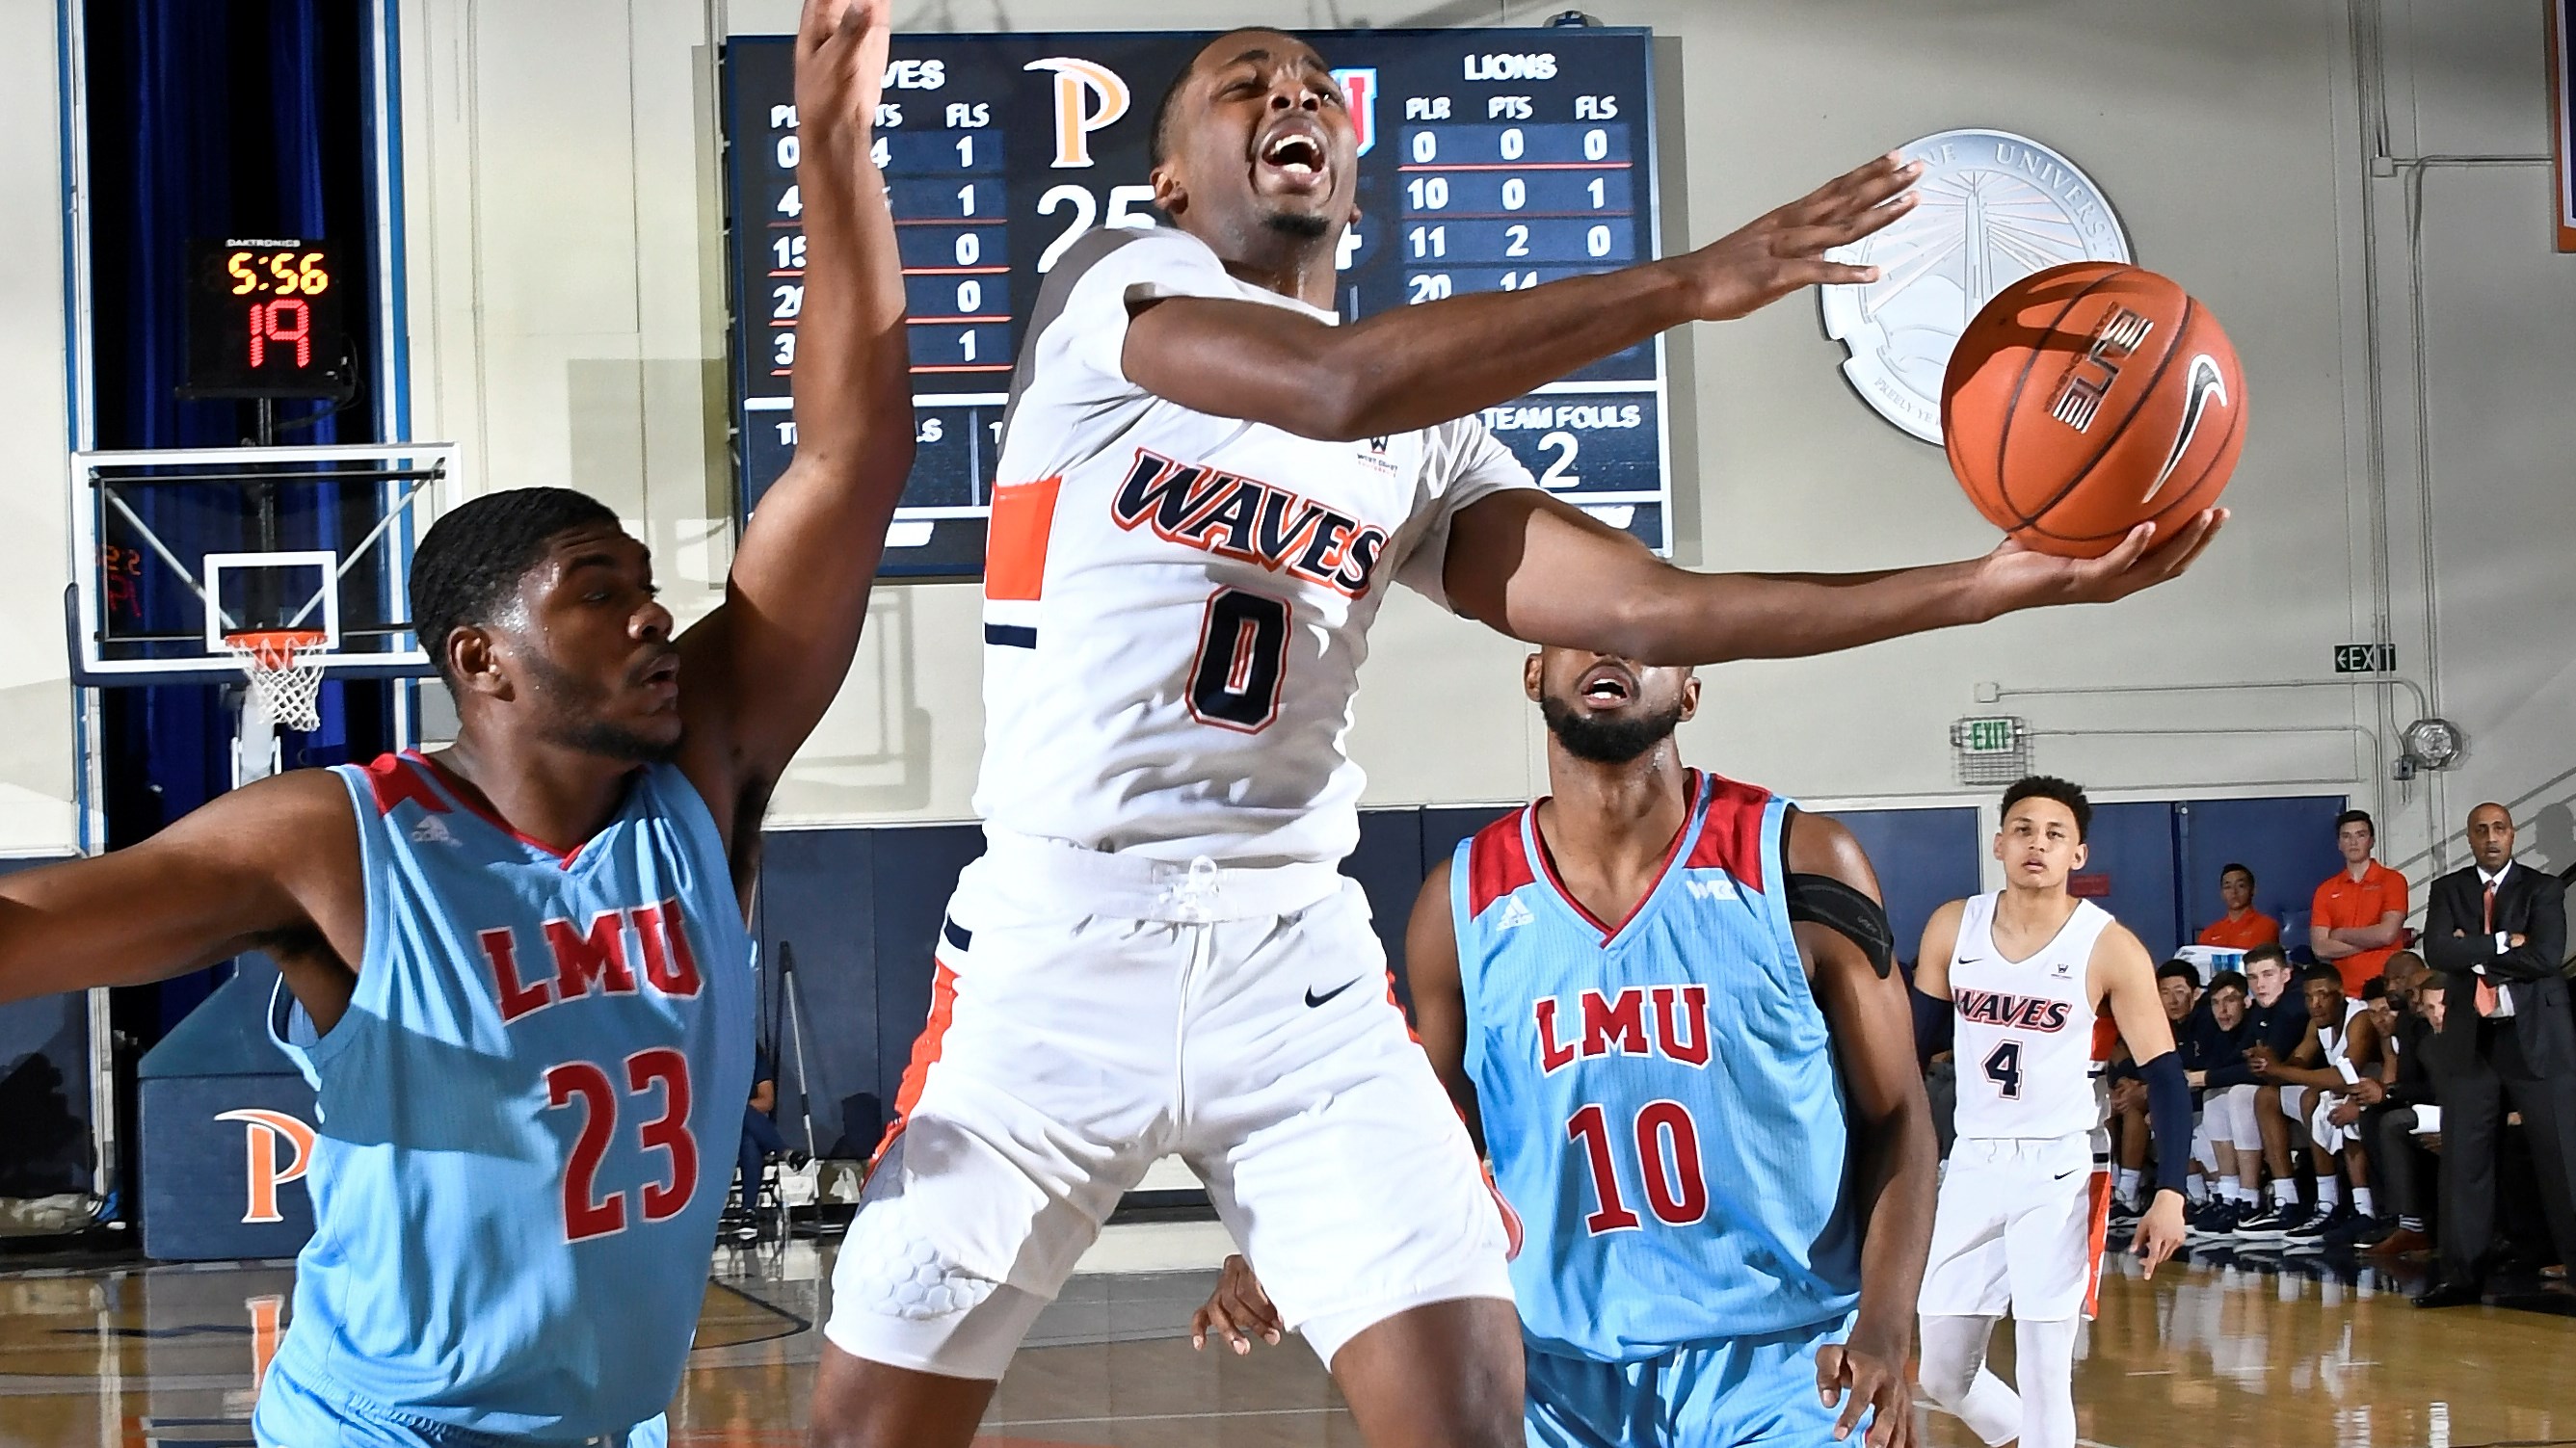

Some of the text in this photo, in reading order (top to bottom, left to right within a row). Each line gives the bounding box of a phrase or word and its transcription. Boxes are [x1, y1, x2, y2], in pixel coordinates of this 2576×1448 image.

[881, 59, 945, 90] VES
[1464, 53, 1557, 81] LIONS
[771, 102, 990, 128] PL TS FLS
[1023, 57, 1130, 168] P
[1406, 95, 1618, 120] PLR PTS FLS
[777, 136, 800, 169] 0
[955, 136, 973, 168] 1
[1412, 128, 1607, 163] 0 0 0
[957, 184, 974, 217] 1
[1407, 177, 1605, 210] 10 0 1
[955, 233, 979, 266] 0
[1409, 224, 1610, 258] 11 2 0
[228, 252, 328, 295] 5:56
[957, 279, 981, 313] 0
[250, 299, 309, 368] 19
[958, 329, 976, 362] 1
[1479, 405, 1641, 431] TEAM FOULS
[1537, 431, 1580, 488] 2
[1111, 446, 1391, 601] WAVES
[1184, 584, 1293, 735] 0
[2350, 646, 2394, 671] EXIT
[1973, 722, 2007, 750] EXIT
[477, 897, 705, 1027] LMU
[1952, 986, 2073, 1034] WAVES
[1532, 983, 1713, 1078] LMU
[1980, 1039, 2023, 1101] 4
[543, 1047, 699, 1246] 23
[214, 1108, 316, 1224] P
[1565, 1098, 1709, 1237] 10
